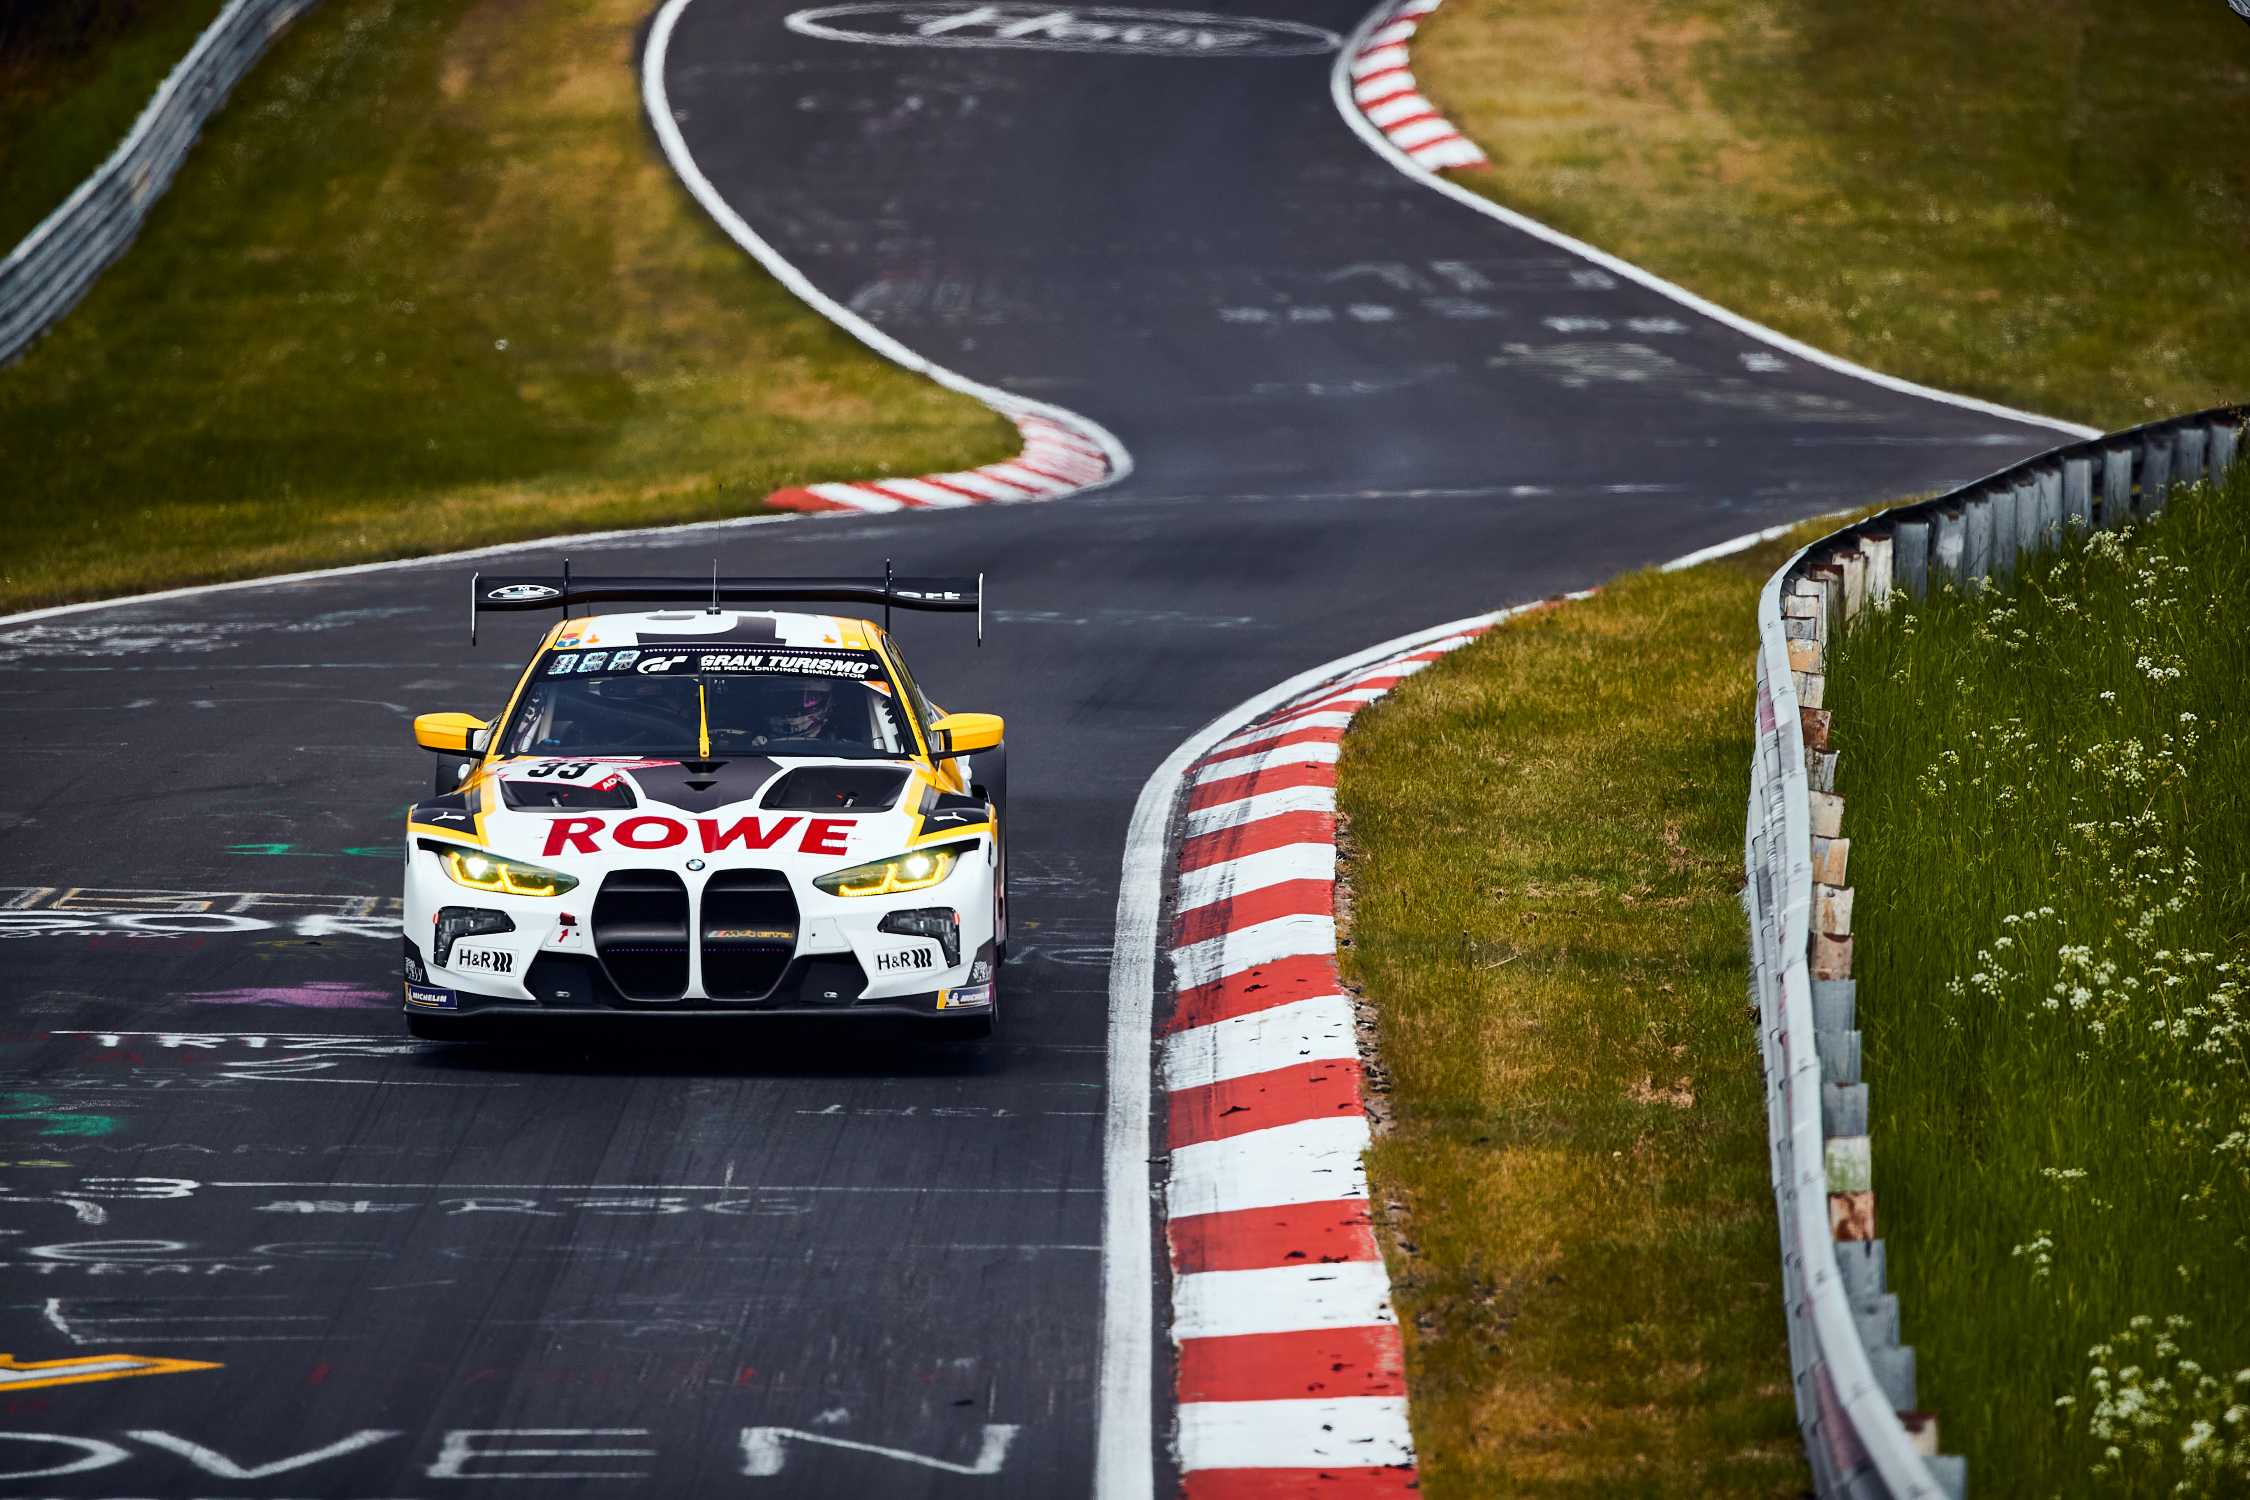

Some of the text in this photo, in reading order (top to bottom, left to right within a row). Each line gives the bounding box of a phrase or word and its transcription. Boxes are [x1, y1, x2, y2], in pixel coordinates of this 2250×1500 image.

[701, 654, 763, 667] GRAN
[802, 668, 865, 680] SIMULATOR
[541, 815, 859, 857] ROWE
[458, 946, 492, 970] H&R
[877, 948, 912, 972] H&R
[412, 990, 448, 1003] MICHELIN
